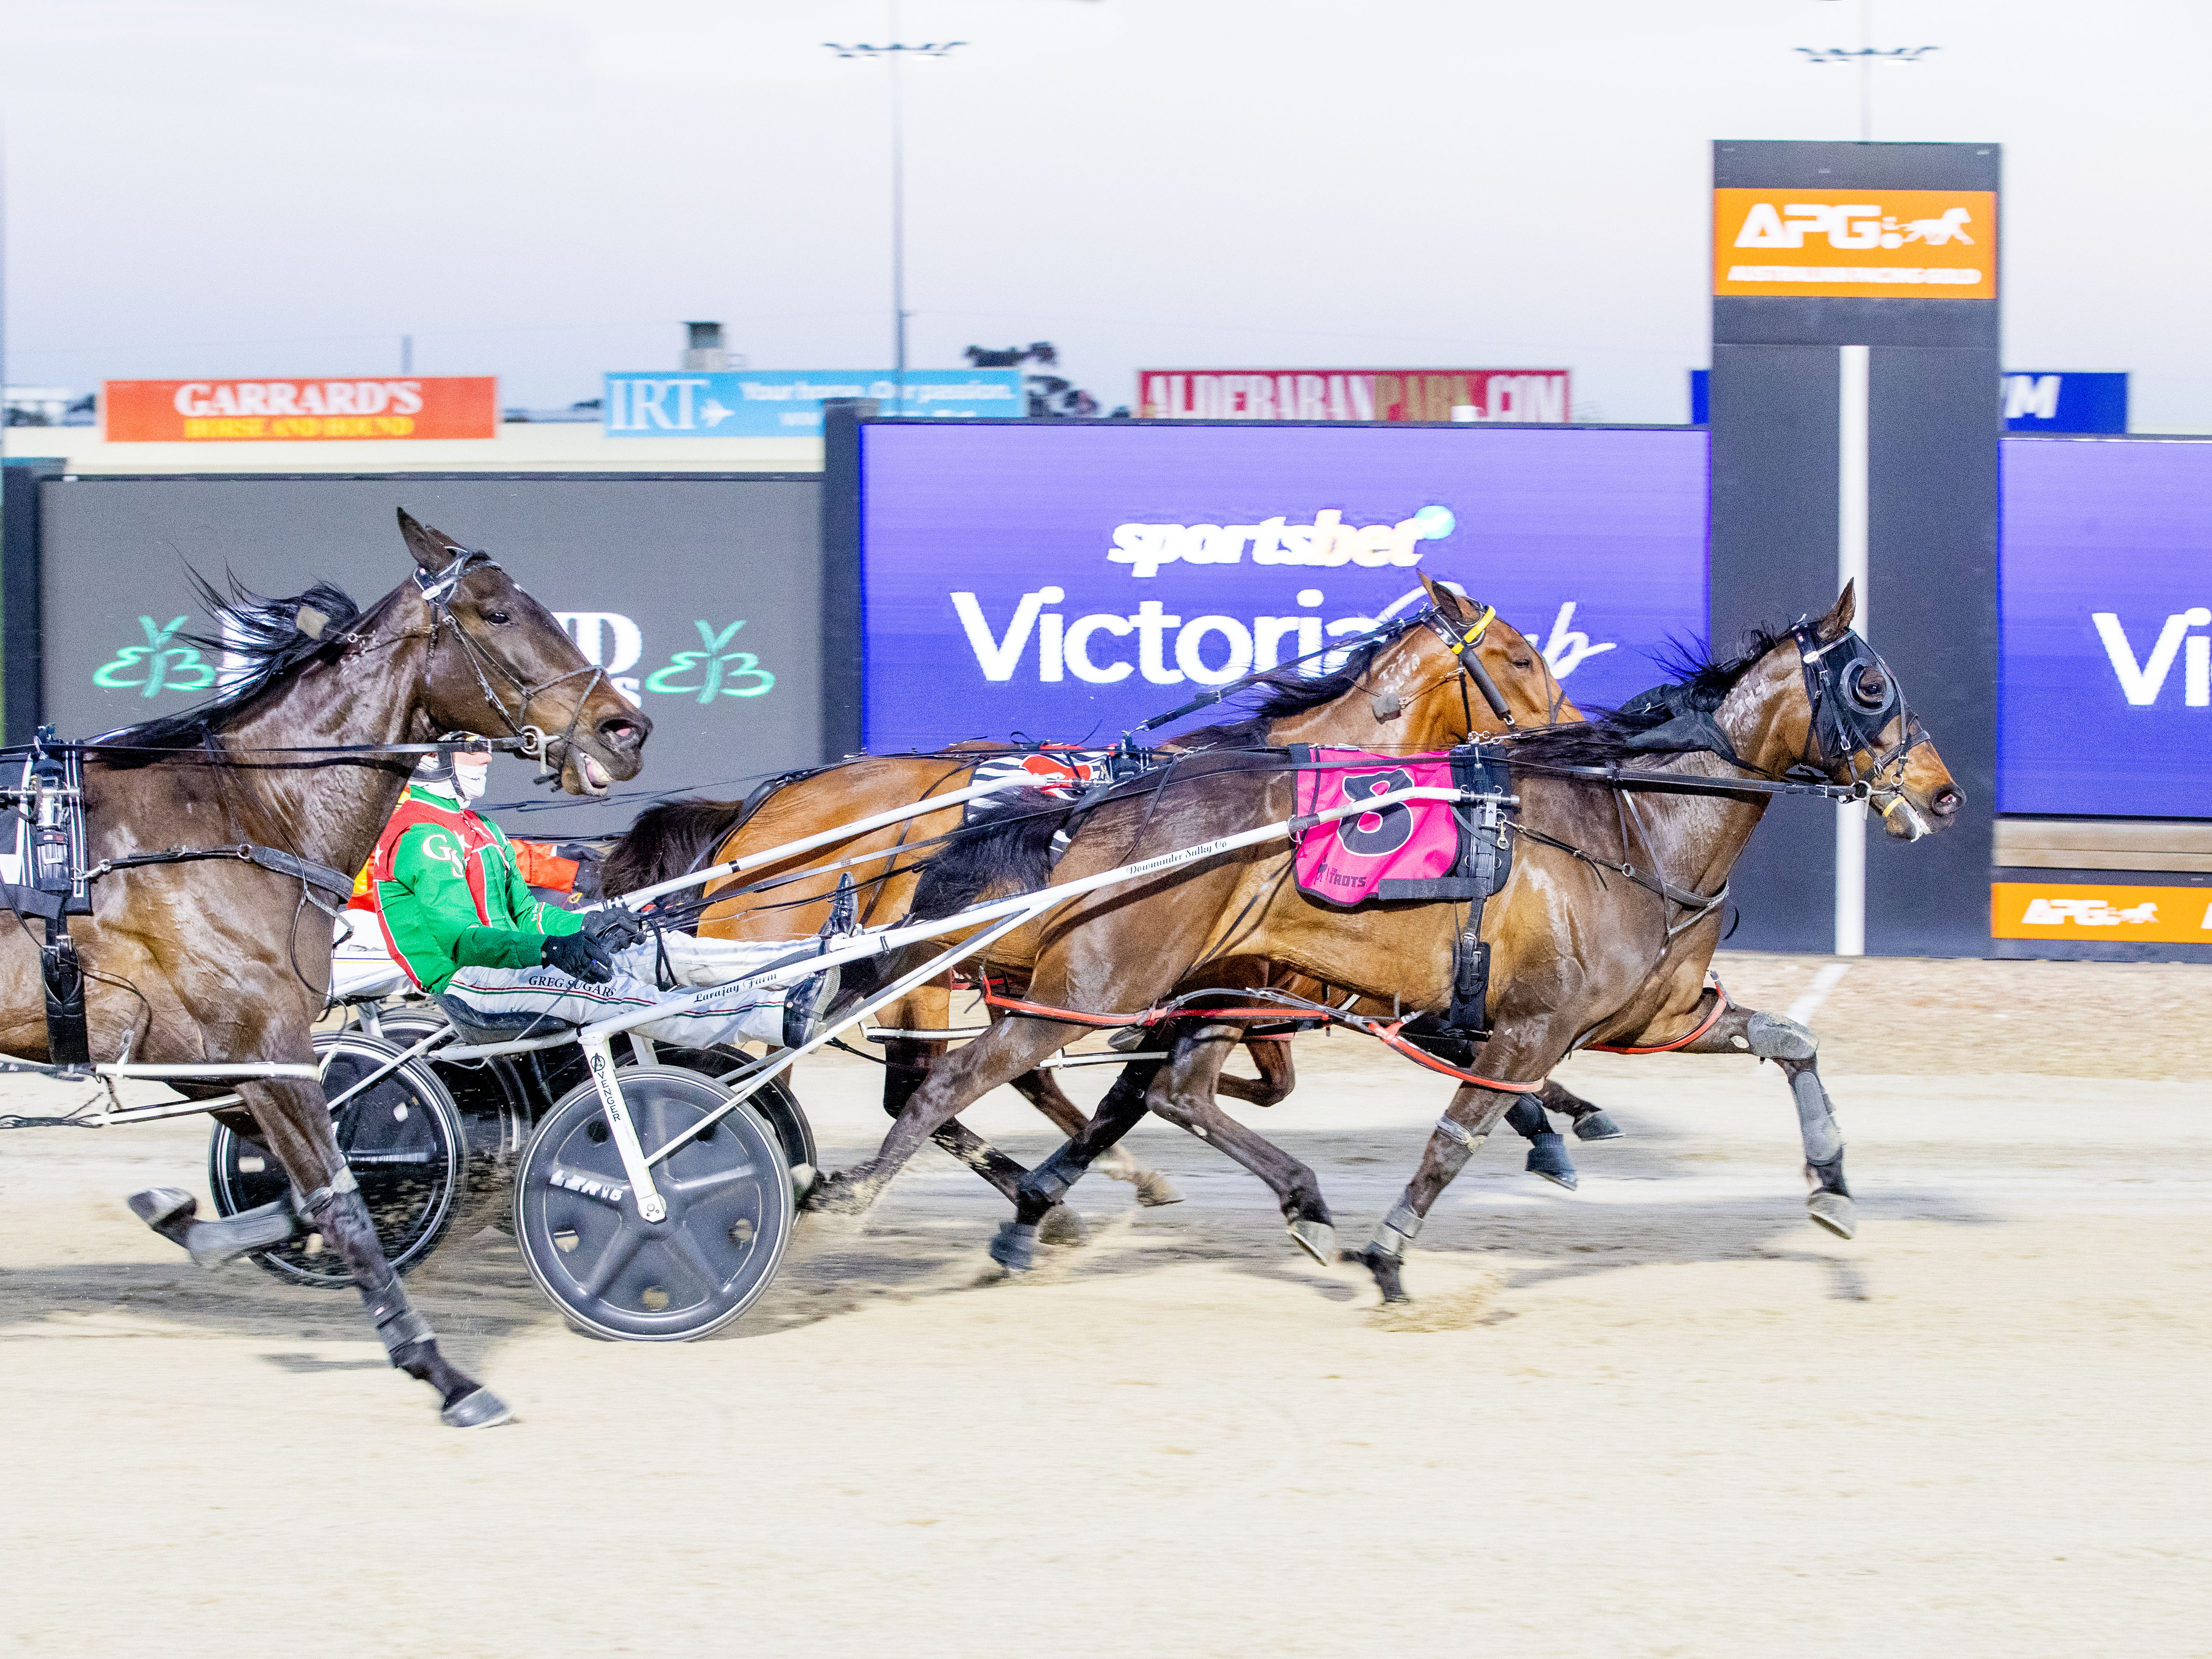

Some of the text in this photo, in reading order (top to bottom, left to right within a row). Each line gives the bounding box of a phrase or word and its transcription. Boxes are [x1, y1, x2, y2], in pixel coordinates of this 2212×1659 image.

[1733, 203, 1882, 249] APG
[173, 381, 422, 416] GARRARD'S
[608, 379, 709, 430] IRT
[1106, 508, 1424, 578] sportsbet
[2091, 607, 2212, 707] Vi
[1337, 768, 1415, 857] 8
[1127, 840, 1227, 875] Downunder Sulky Co
[1329, 872, 1366, 887] TROTS
[528, 976, 616, 997] GREG SUGARS
[694, 974, 777, 1004] Larajay Farm
